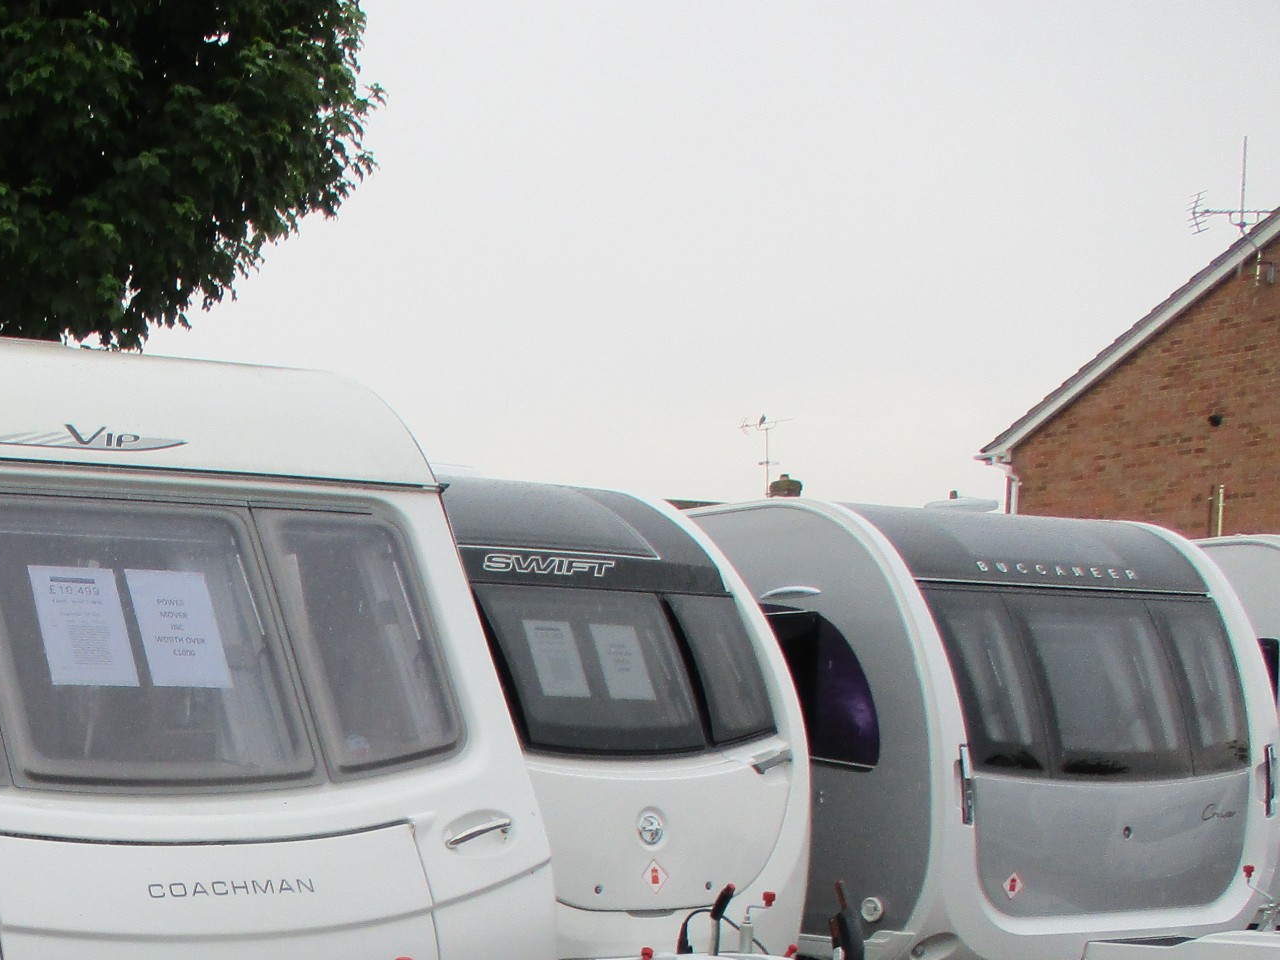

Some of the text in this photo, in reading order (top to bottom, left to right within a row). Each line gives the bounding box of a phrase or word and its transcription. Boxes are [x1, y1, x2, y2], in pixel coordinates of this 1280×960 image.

[483, 553, 615, 577] SWIFT
[976, 560, 1138, 580] BUCCANEER
[156, 598, 185, 607] POWER
[159, 611, 188, 619] MOVER
[154, 635, 206, 645] WORTH OVER
[148, 879, 315, 898] COACHMAN
